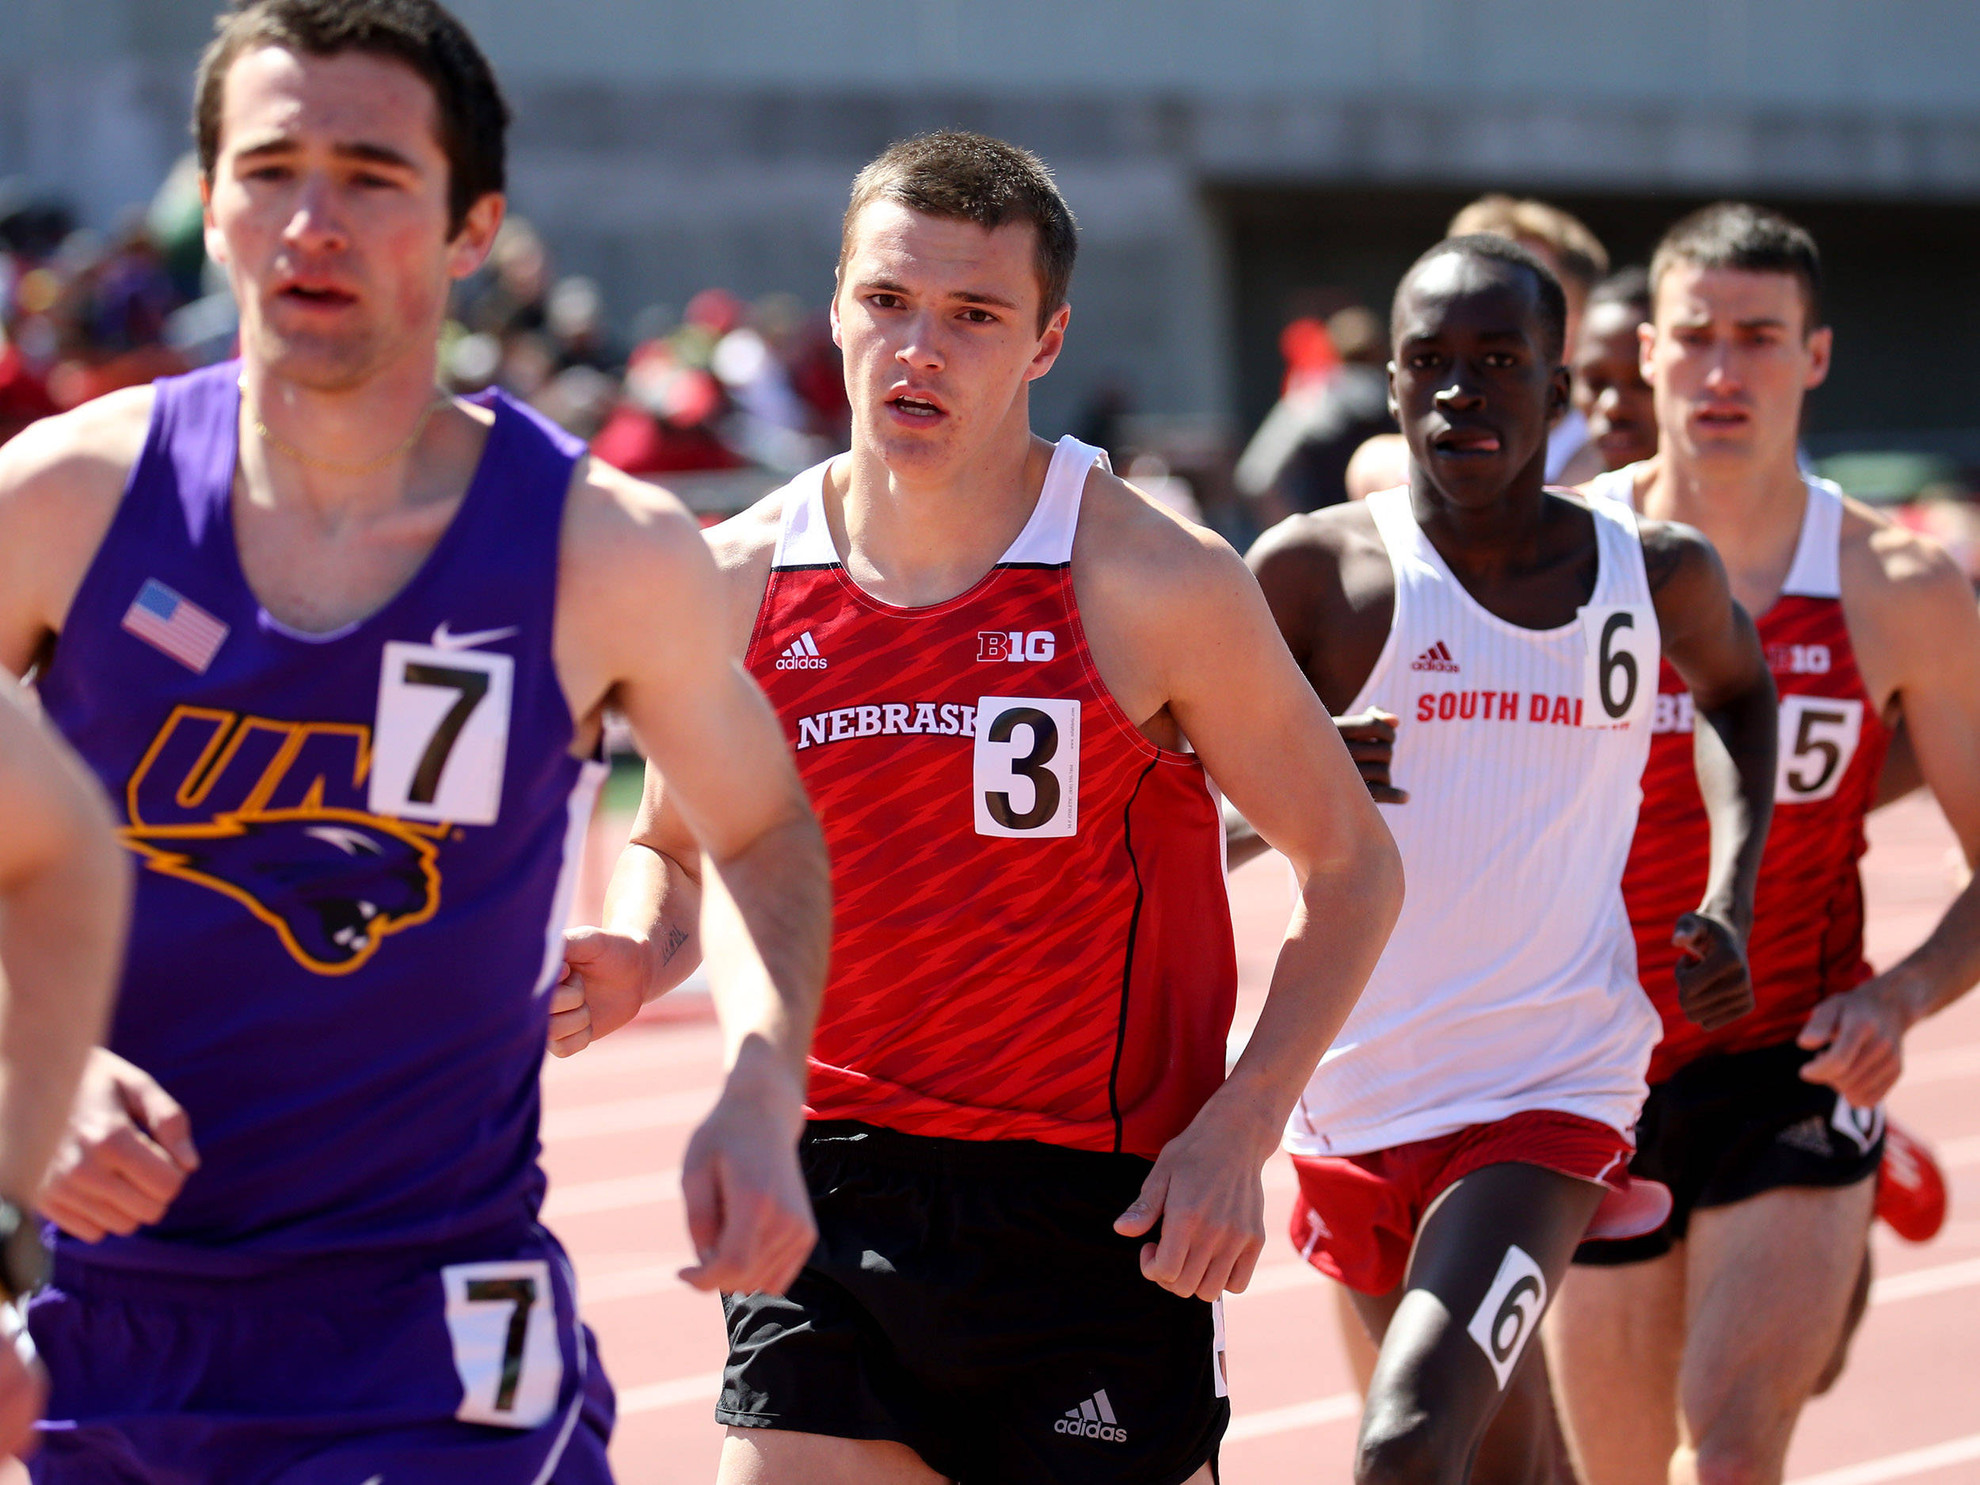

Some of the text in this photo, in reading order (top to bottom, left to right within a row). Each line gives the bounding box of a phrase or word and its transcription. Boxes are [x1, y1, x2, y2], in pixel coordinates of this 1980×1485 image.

[776, 656, 828, 670] adidas
[1412, 660, 1460, 673] adidas
[1599, 611, 1638, 719] 6
[403, 661, 490, 805] 7
[796, 702, 977, 750] NEBRASK
[1416, 691, 1520, 722] SOUTH
[984, 706, 1061, 830] 3
[1787, 709, 1846, 794] 5
[465, 1277, 537, 1412] 7
[1491, 1274, 1541, 1364] 6
[1053, 1417, 1128, 1443] adidas
